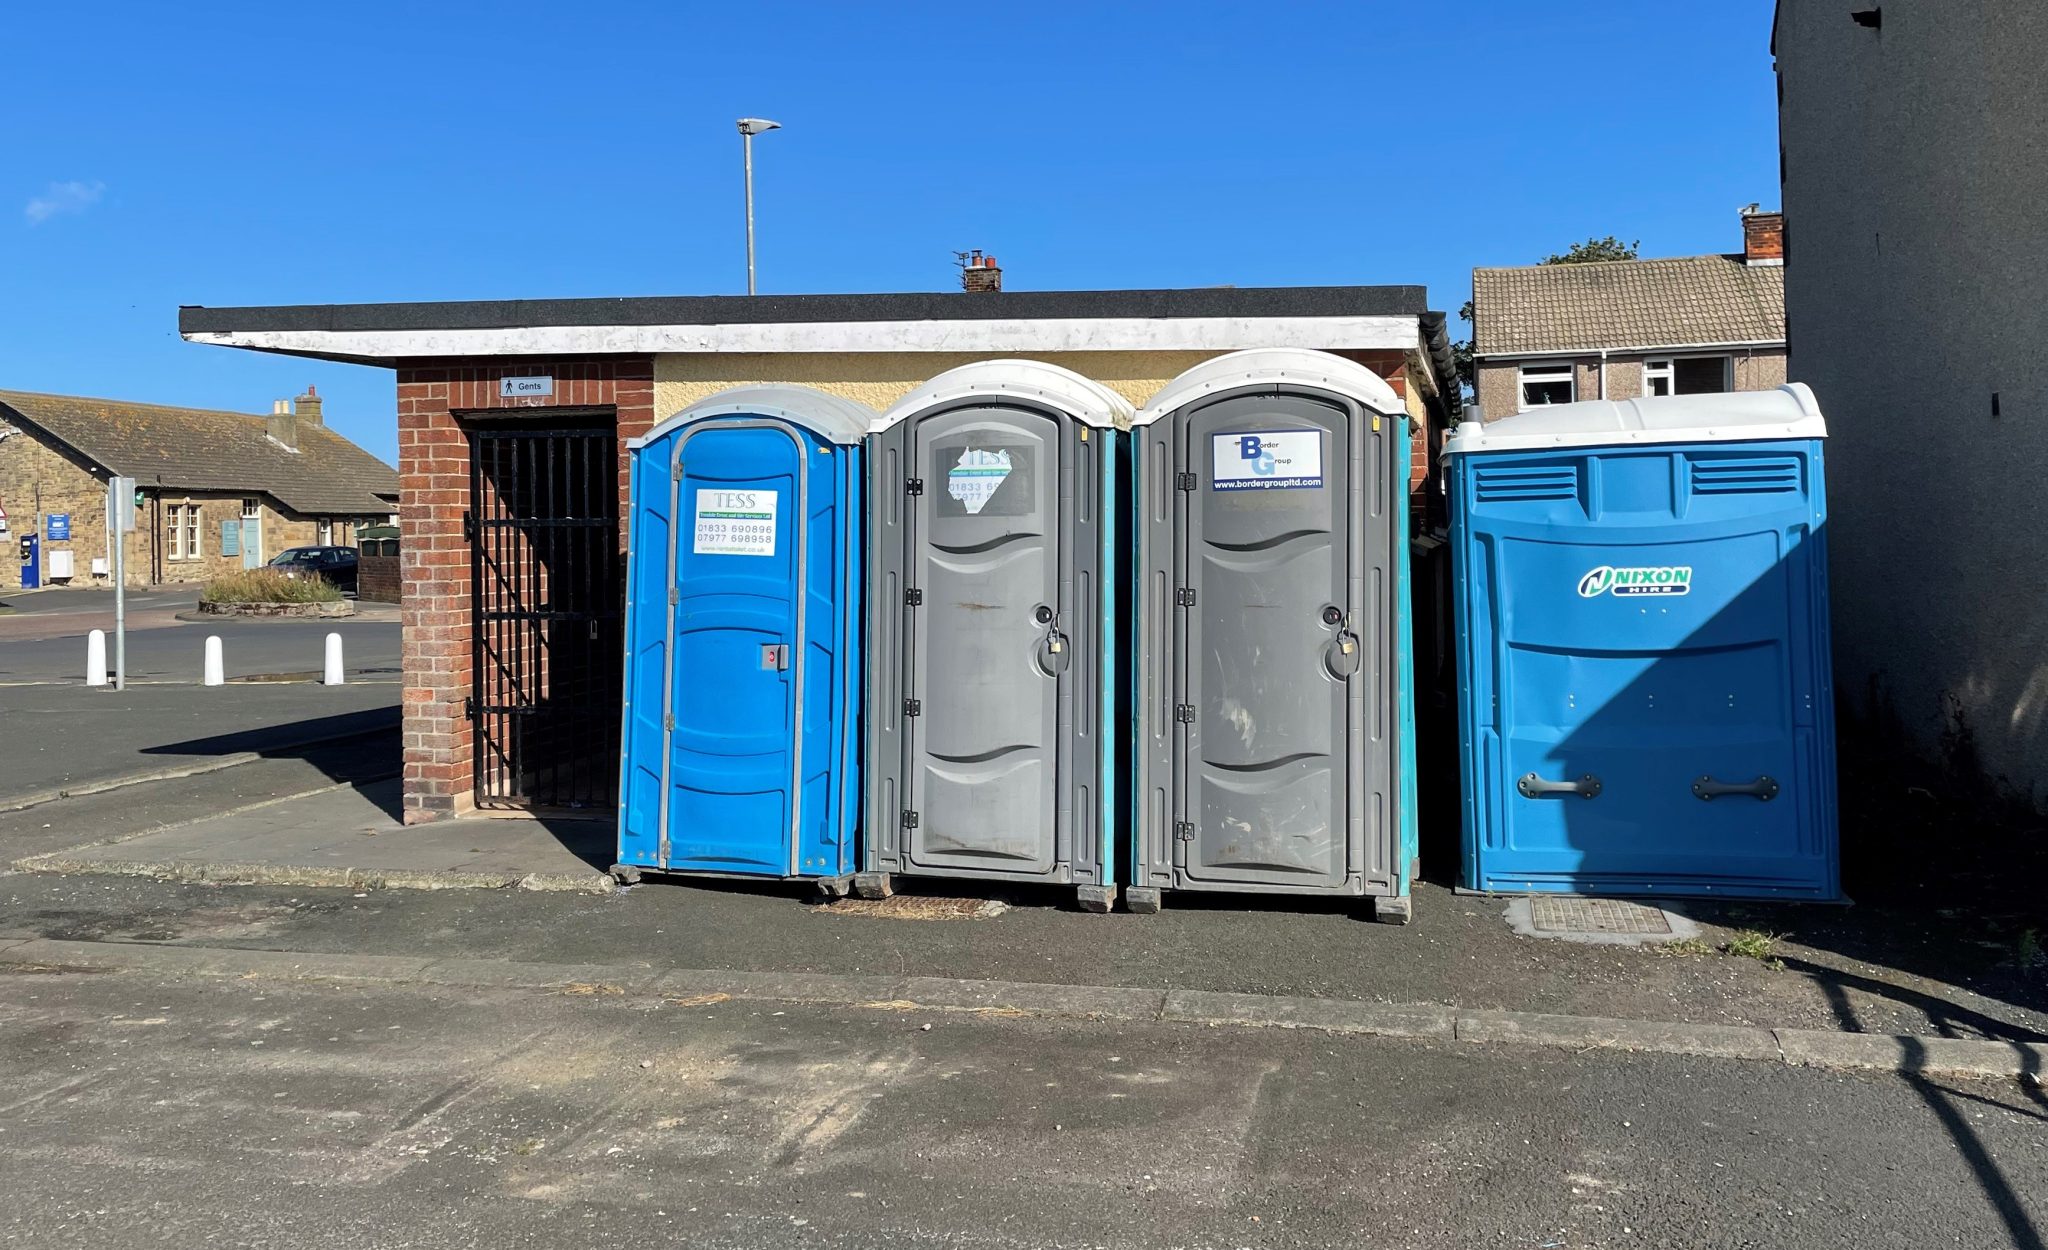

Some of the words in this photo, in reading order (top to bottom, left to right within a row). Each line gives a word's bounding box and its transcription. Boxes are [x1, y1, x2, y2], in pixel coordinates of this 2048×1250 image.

[949, 483, 981, 491] 01833
[1214, 479, 1321, 489] www.bordergroupltd.com
[714, 492, 756, 508] TESS
[698, 524, 727, 532] 01833
[732, 525, 772, 533] 690896
[698, 534, 727, 542] 07977
[731, 535, 772, 543] 698958
[1615, 570, 1689, 583] NIXON
